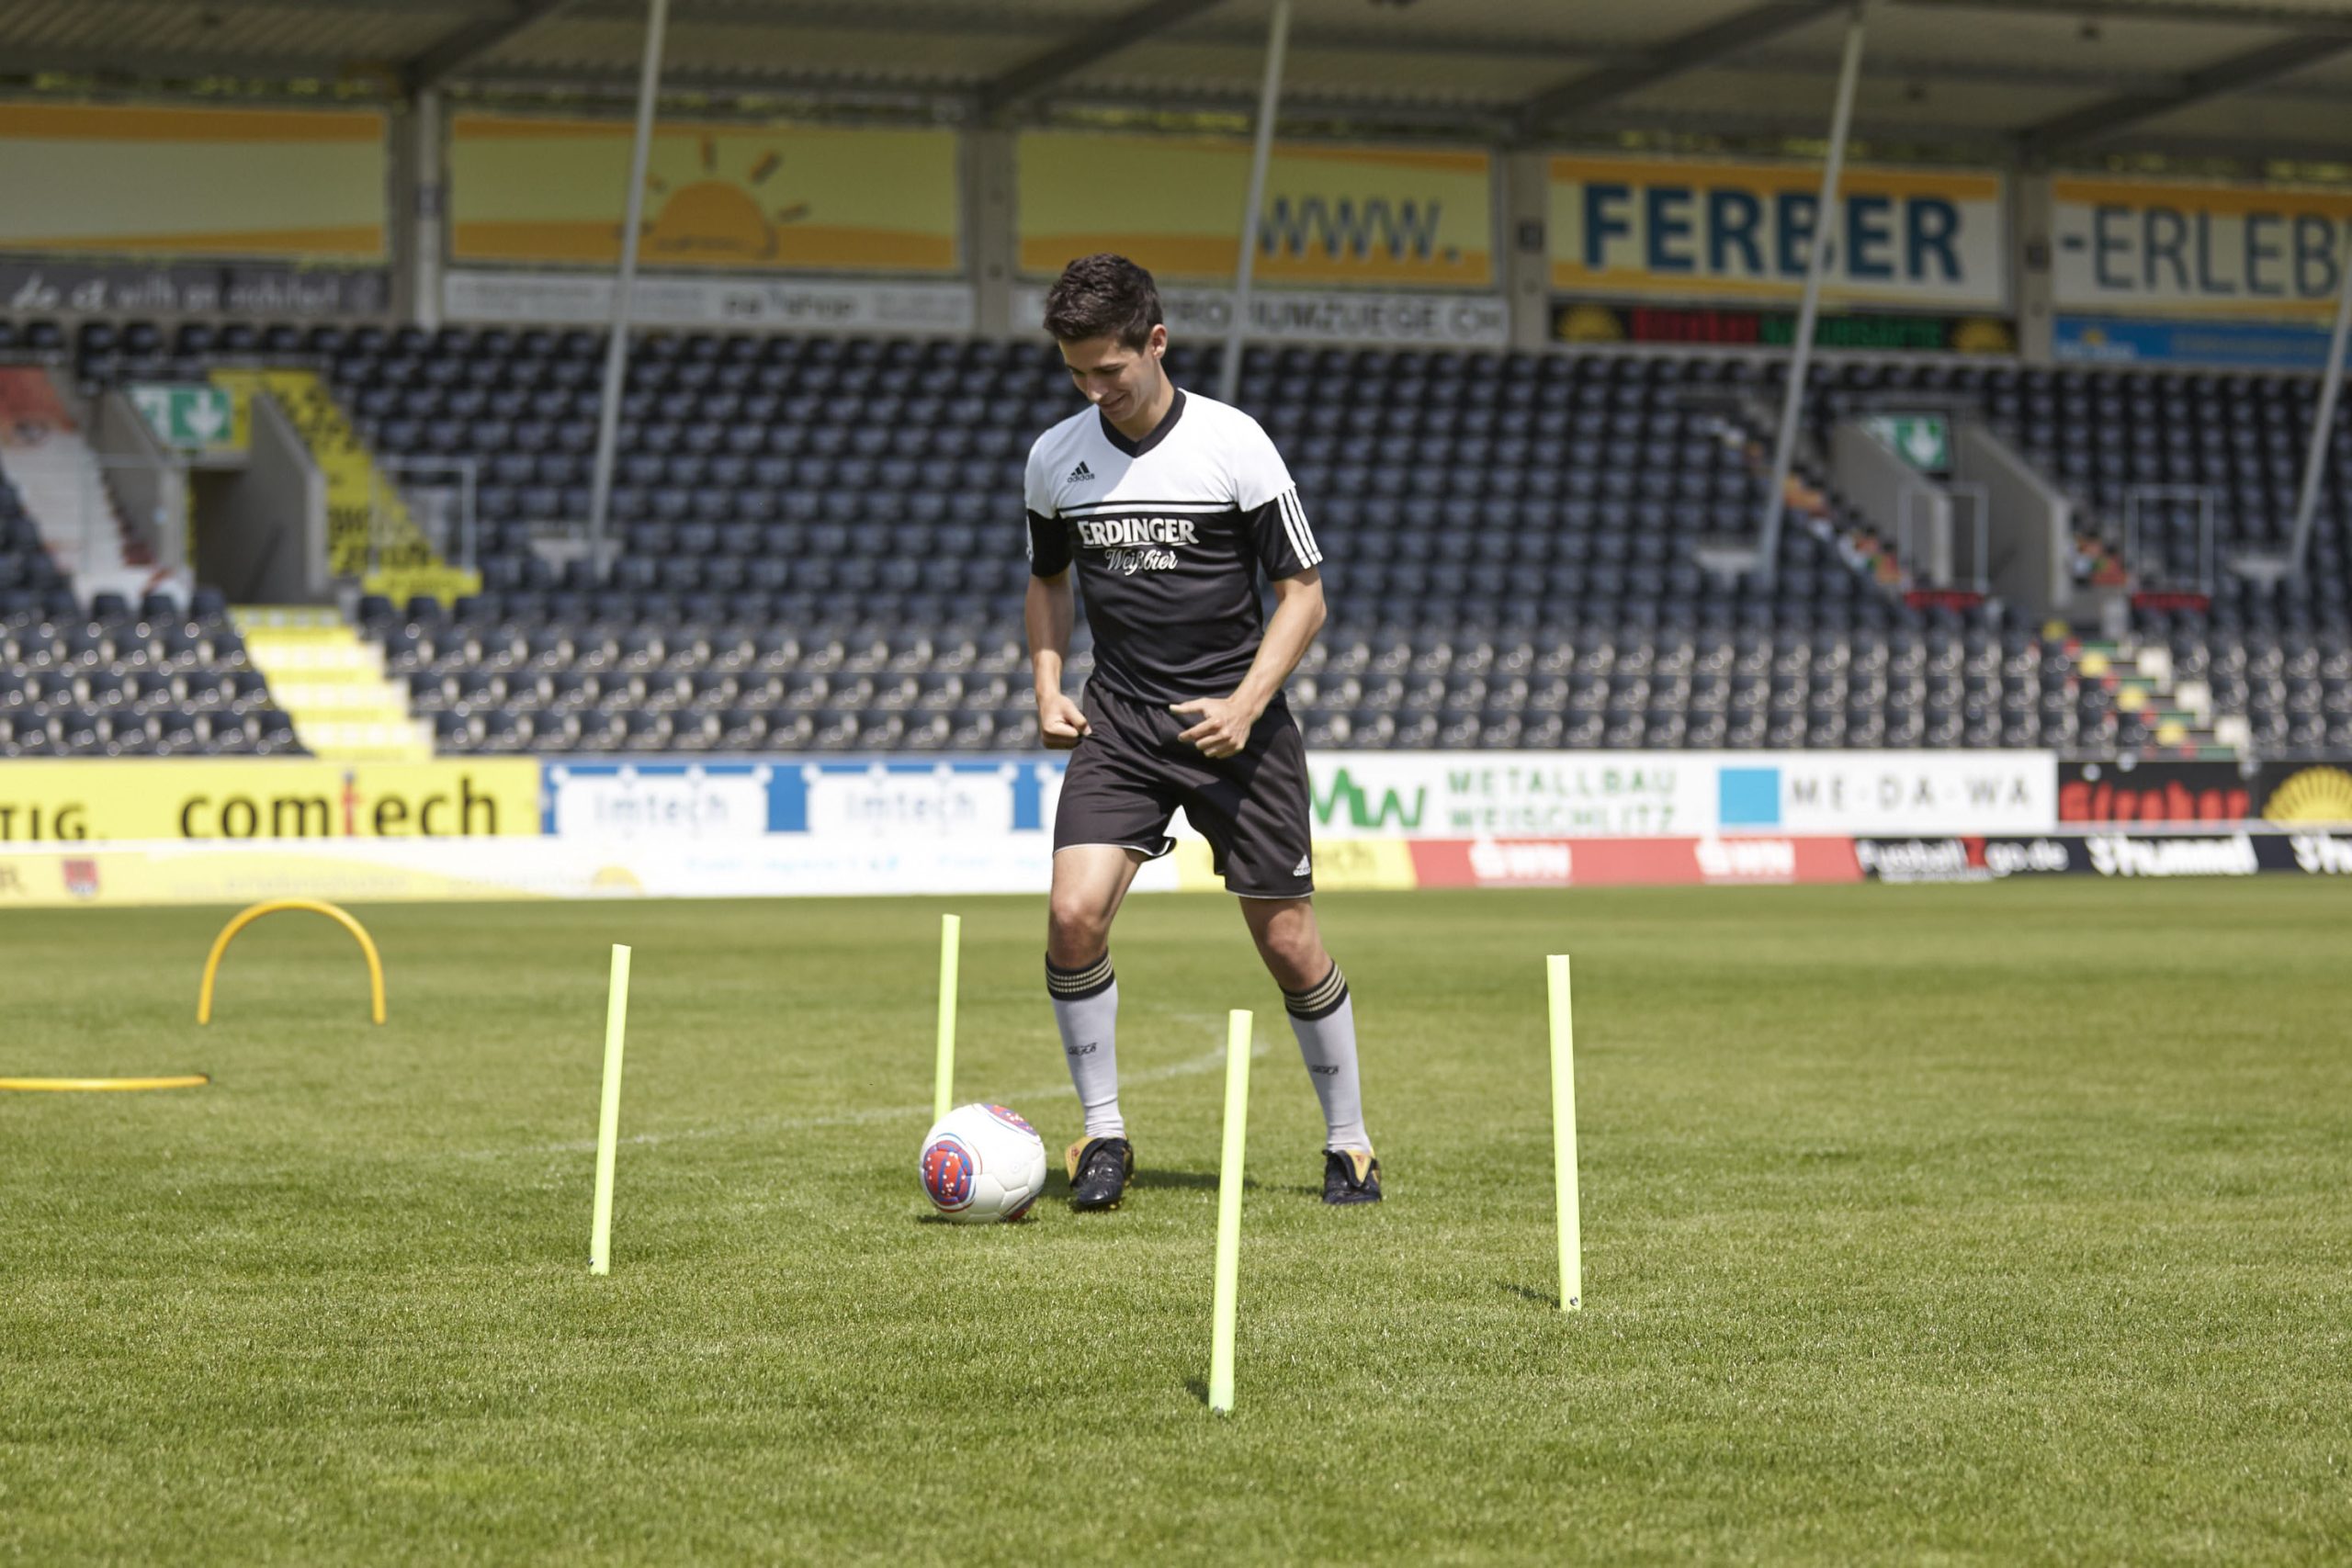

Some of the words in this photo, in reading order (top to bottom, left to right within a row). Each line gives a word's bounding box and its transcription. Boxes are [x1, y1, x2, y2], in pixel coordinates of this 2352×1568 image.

[1584, 183, 1962, 280] FERBER
[2060, 202, 2352, 299] -ERLEB
[1067, 472, 1096, 484] adidas
[1078, 516, 1199, 548] ERDINGER
[1104, 547, 1179, 577] Weißbier
[1448, 768, 1678, 795] METALLBAU
[179, 771, 498, 838] comtech
[1449, 805, 1677, 830] WEISCHLITZ
